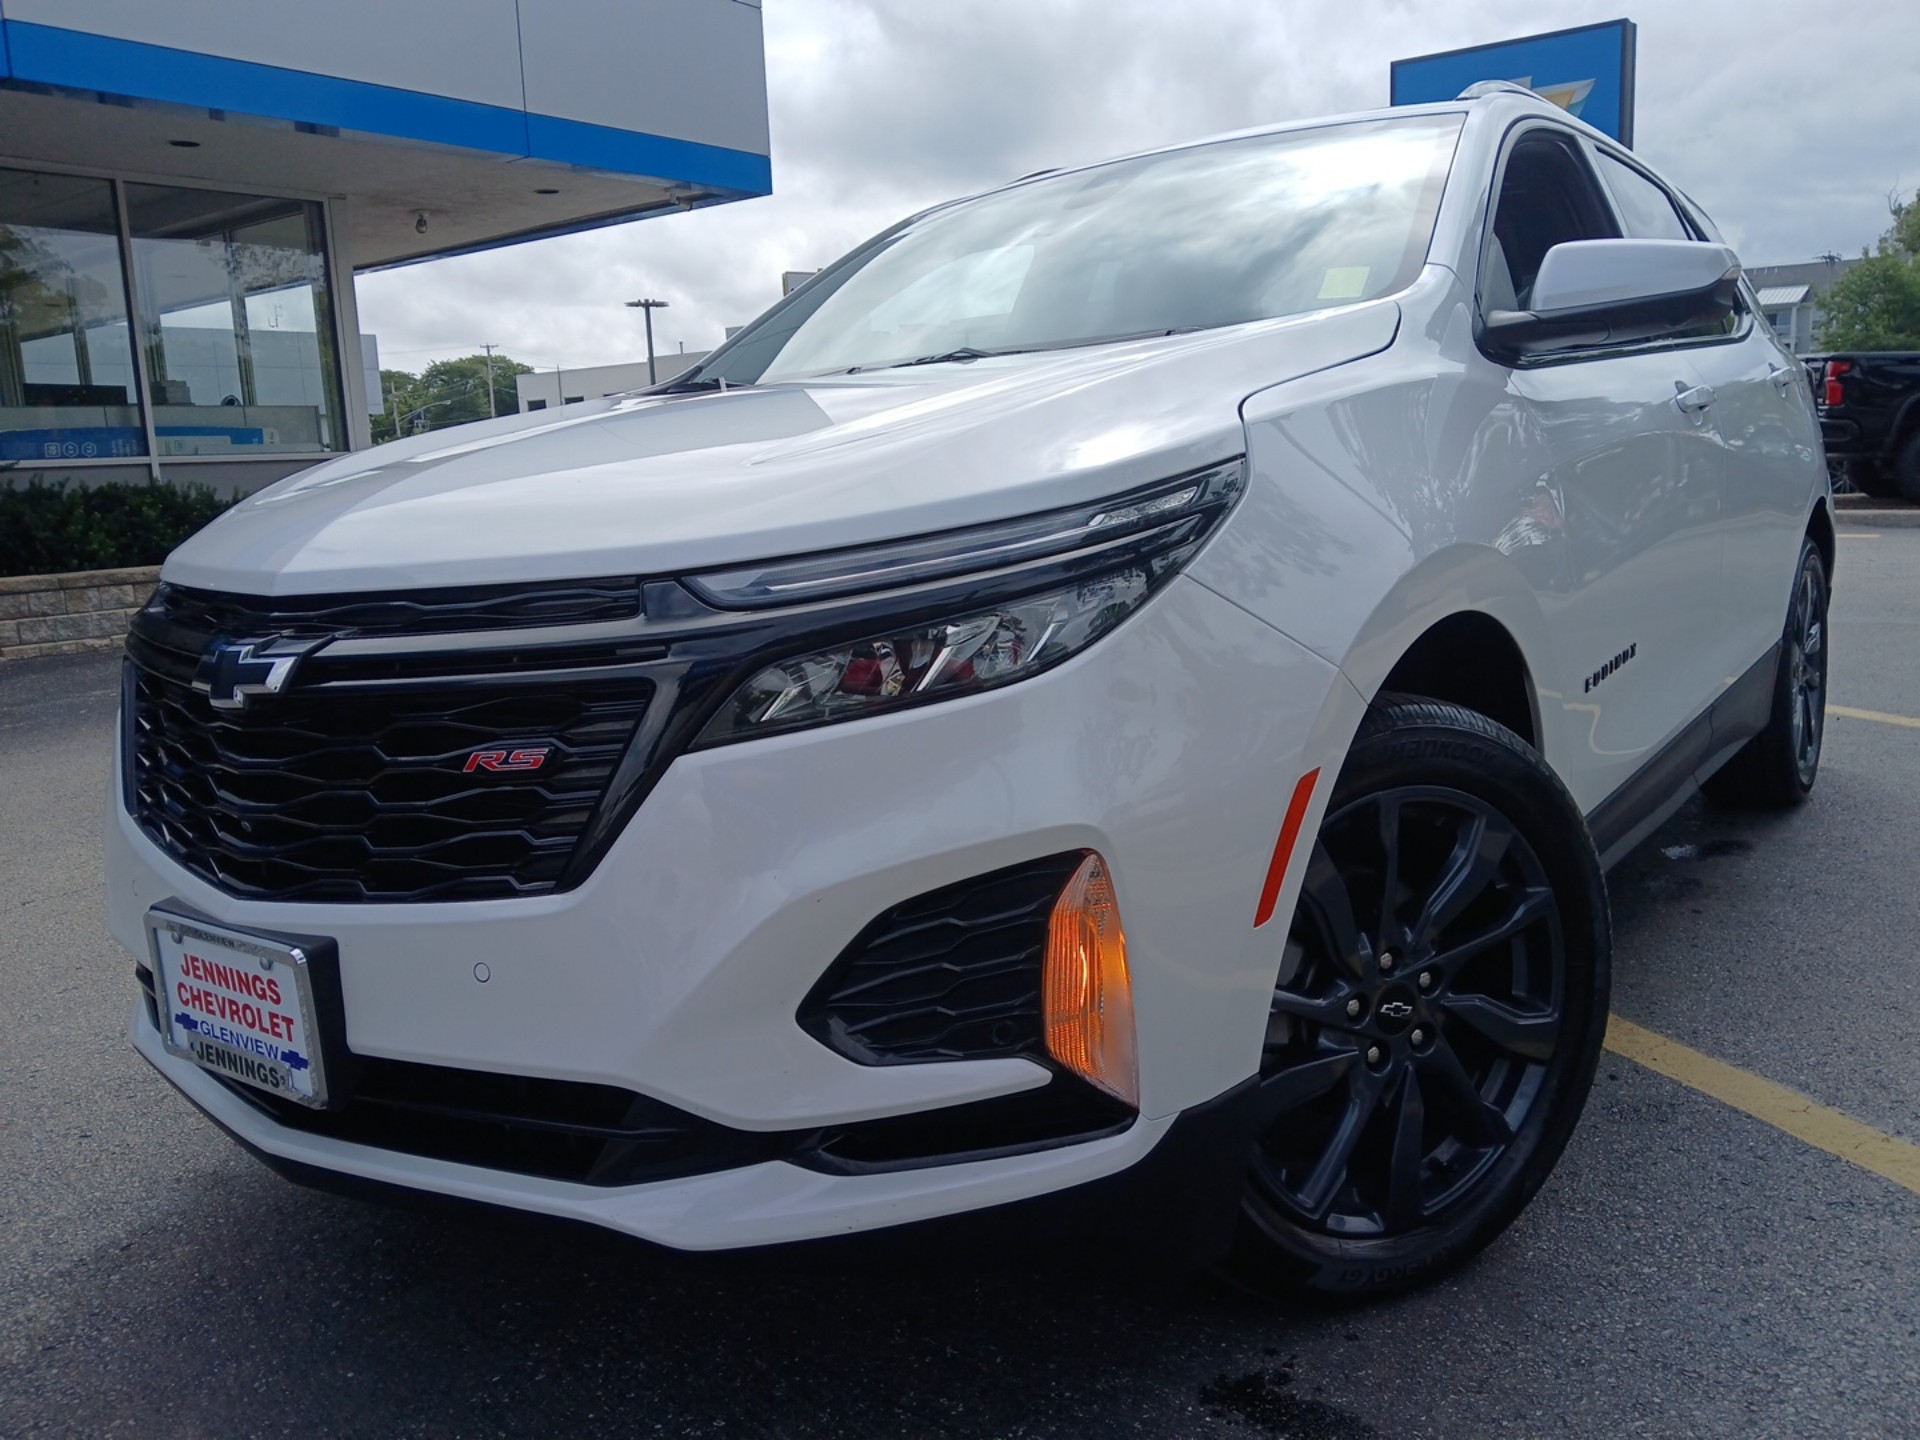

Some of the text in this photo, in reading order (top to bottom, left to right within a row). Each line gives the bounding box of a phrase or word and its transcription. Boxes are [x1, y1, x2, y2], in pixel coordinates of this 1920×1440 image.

[462, 748, 549, 772] RS
[180, 953, 282, 1005] JENNINGS
[177, 982, 294, 1042] CHEVROLET
[200, 1020, 279, 1061] GLENVIEW
[196, 1042, 280, 1088] JENNINGS
